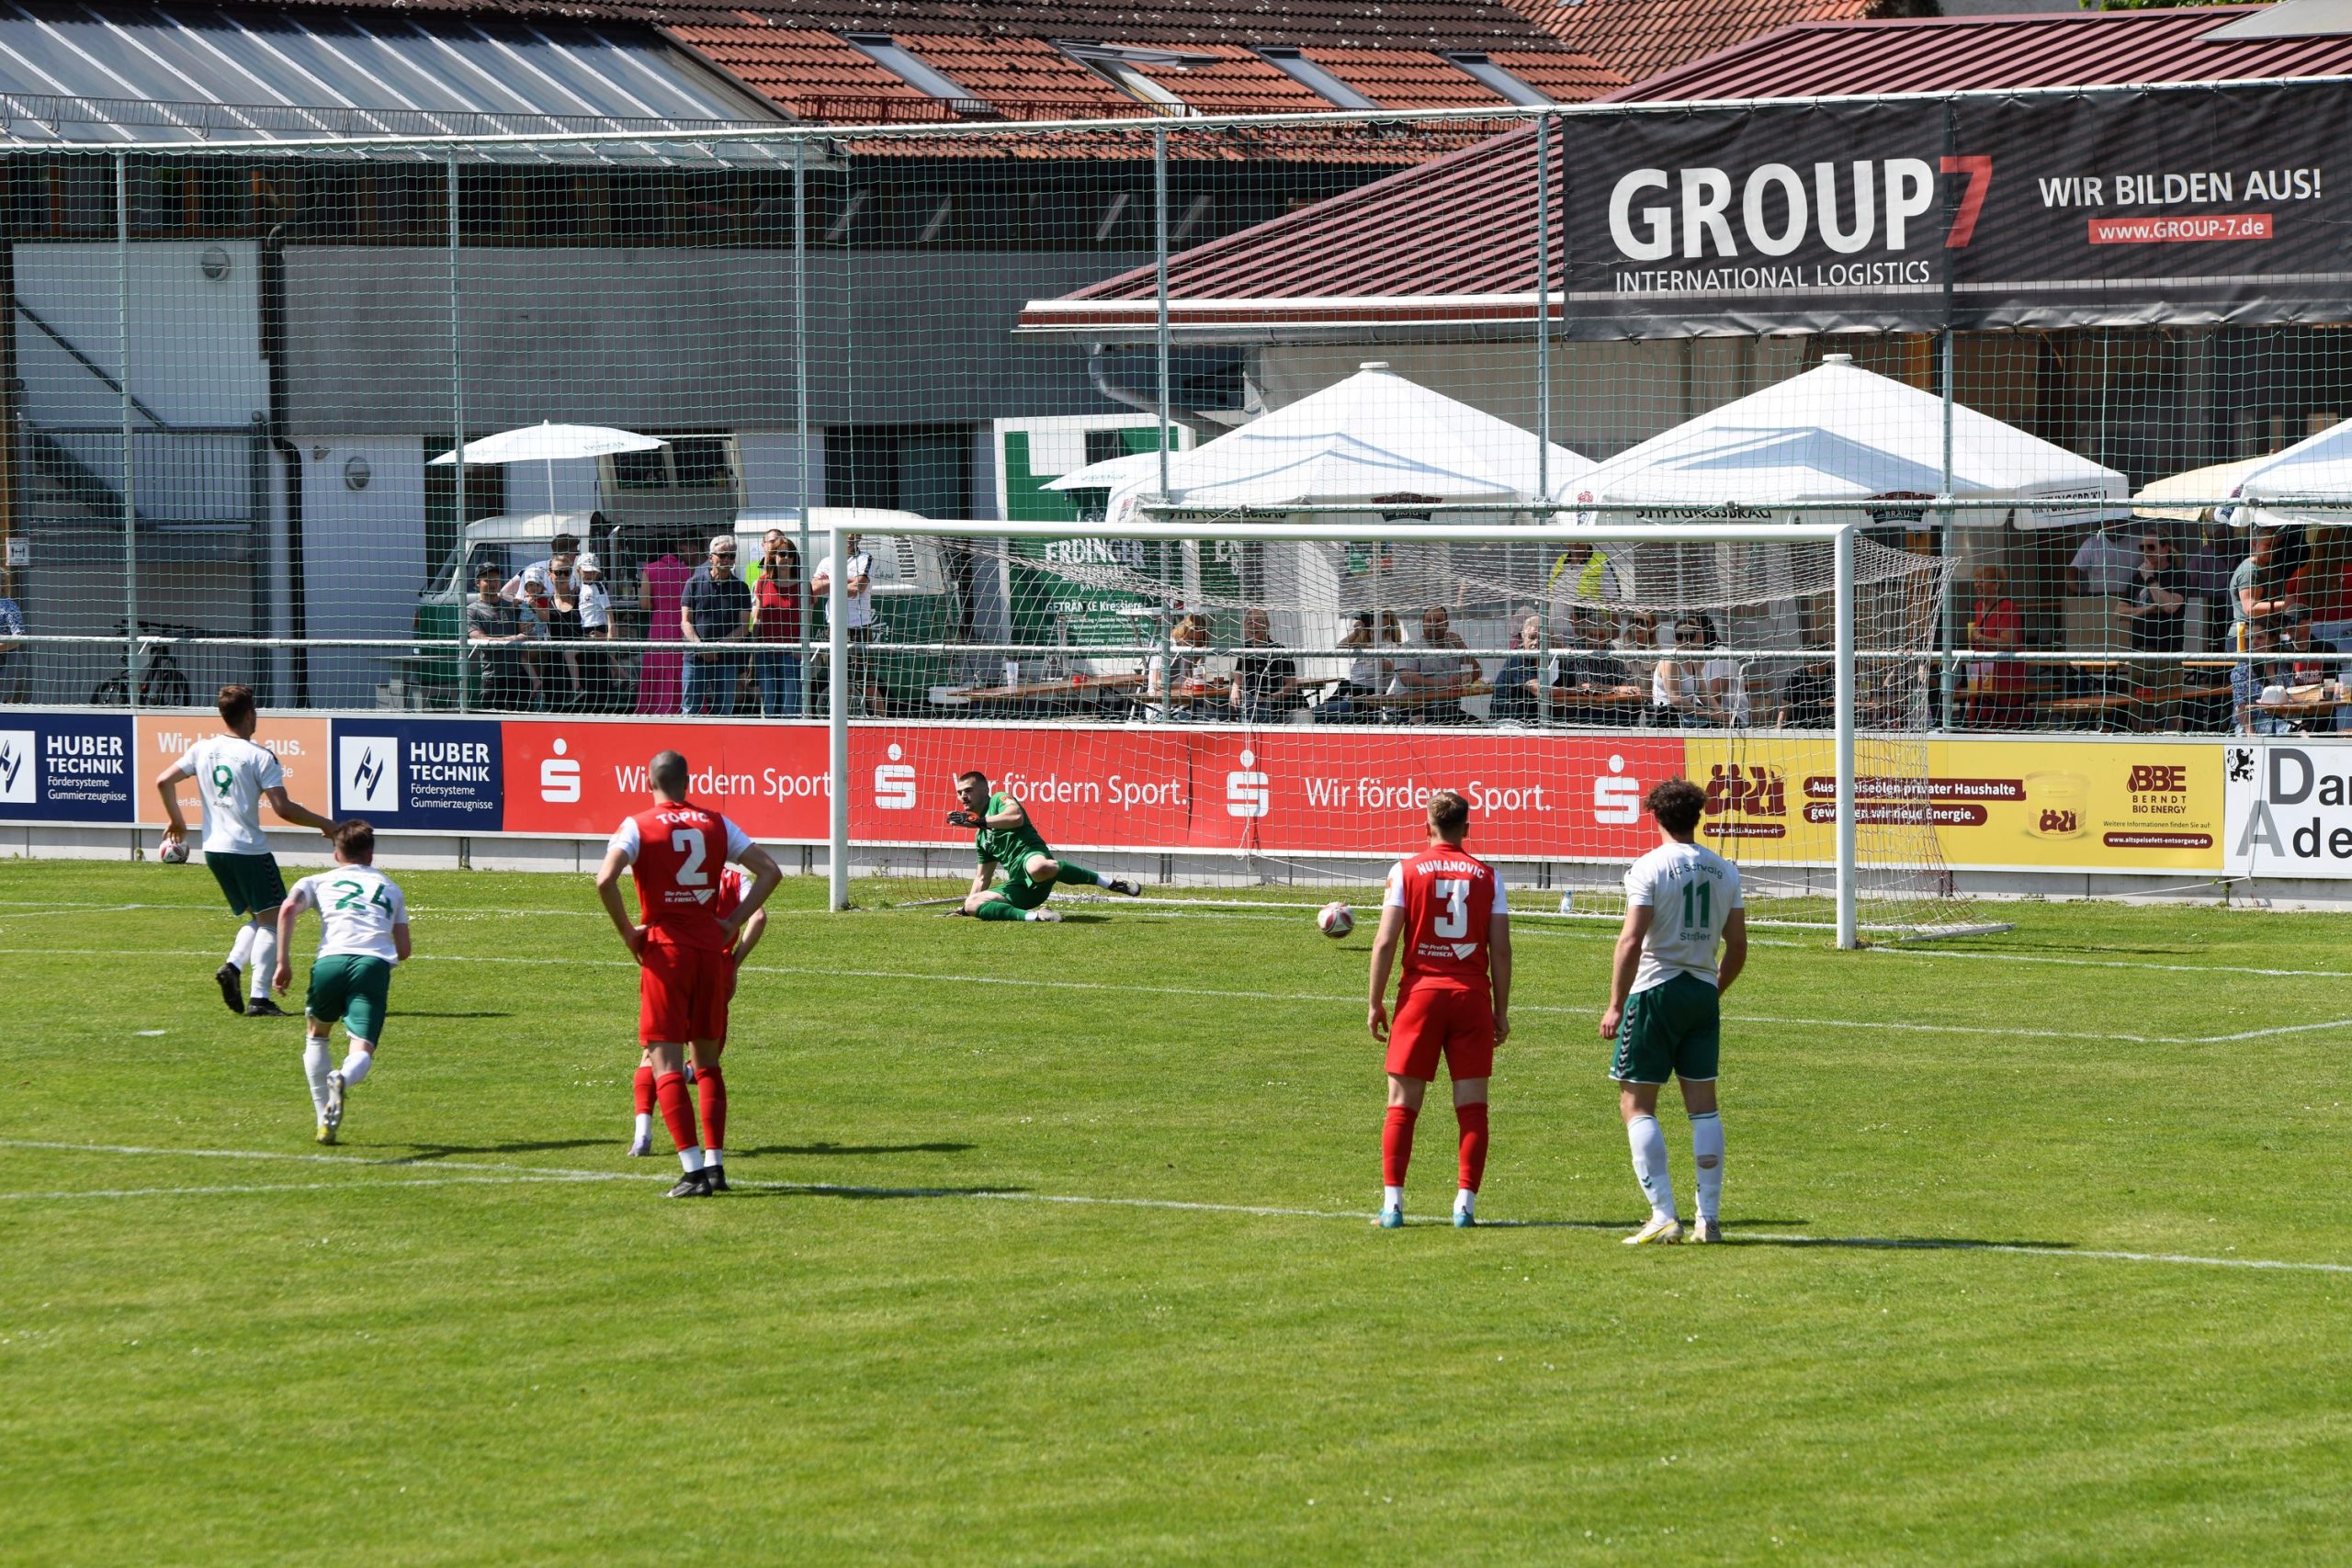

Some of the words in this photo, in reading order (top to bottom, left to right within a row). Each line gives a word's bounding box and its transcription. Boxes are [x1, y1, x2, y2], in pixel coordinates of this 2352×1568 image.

[2039, 176, 2104, 208] WIR
[2115, 172, 2233, 205] BILDEN
[2244, 169, 2322, 201] AUS!
[2098, 218, 2265, 240] www.GROUP-7.de
[1616, 265, 1809, 293] INTERNATIONAL
[1817, 261, 1930, 287] LOGISTICS
[47, 735, 124, 756] HUBER
[410, 741, 491, 763] HUBER
[46, 758, 124, 773] TECHNIK
[409, 764, 491, 782] TECHNIK
[47, 775, 110, 790] Fördersysteme
[212, 765, 233, 798] 9
[615, 765, 650, 794] Wi
[688, 766, 755, 795] rdern
[2132, 764, 2187, 793] BBE
[48, 789, 127, 804] Gummierzeugnisse
[411, 783, 476, 797] Fördersysteme
[1002, 773, 1100, 804] fördern
[1108, 775, 1188, 811] Sport.
[1306, 778, 1351, 807] Wir
[1357, 778, 1458, 808] förde
[1468, 781, 1552, 818] Sport.
[1904, 784, 1951, 796] privater
[1954, 784, 2016, 795] Haushalte
[2132, 795, 2187, 804] BERNDT
[411, 796, 493, 812] Gummierzeugnisse
[2132, 805, 2148, 814] BIO
[2151, 805, 2187, 814] ENERGY
[655, 811, 710, 825] TOPIC
[1926, 807, 1975, 822] Energie.
[2127, 820, 2169, 829] Informationen
[2108, 837, 2208, 845] www.altspeisefett-entsorgung.de
[672, 829, 708, 886] 2
[1415, 860, 1486, 879] NUMANOVIC
[332, 879, 394, 920] 24
[1433, 879, 1471, 939] 3
[1682, 880, 1711, 929] 11
